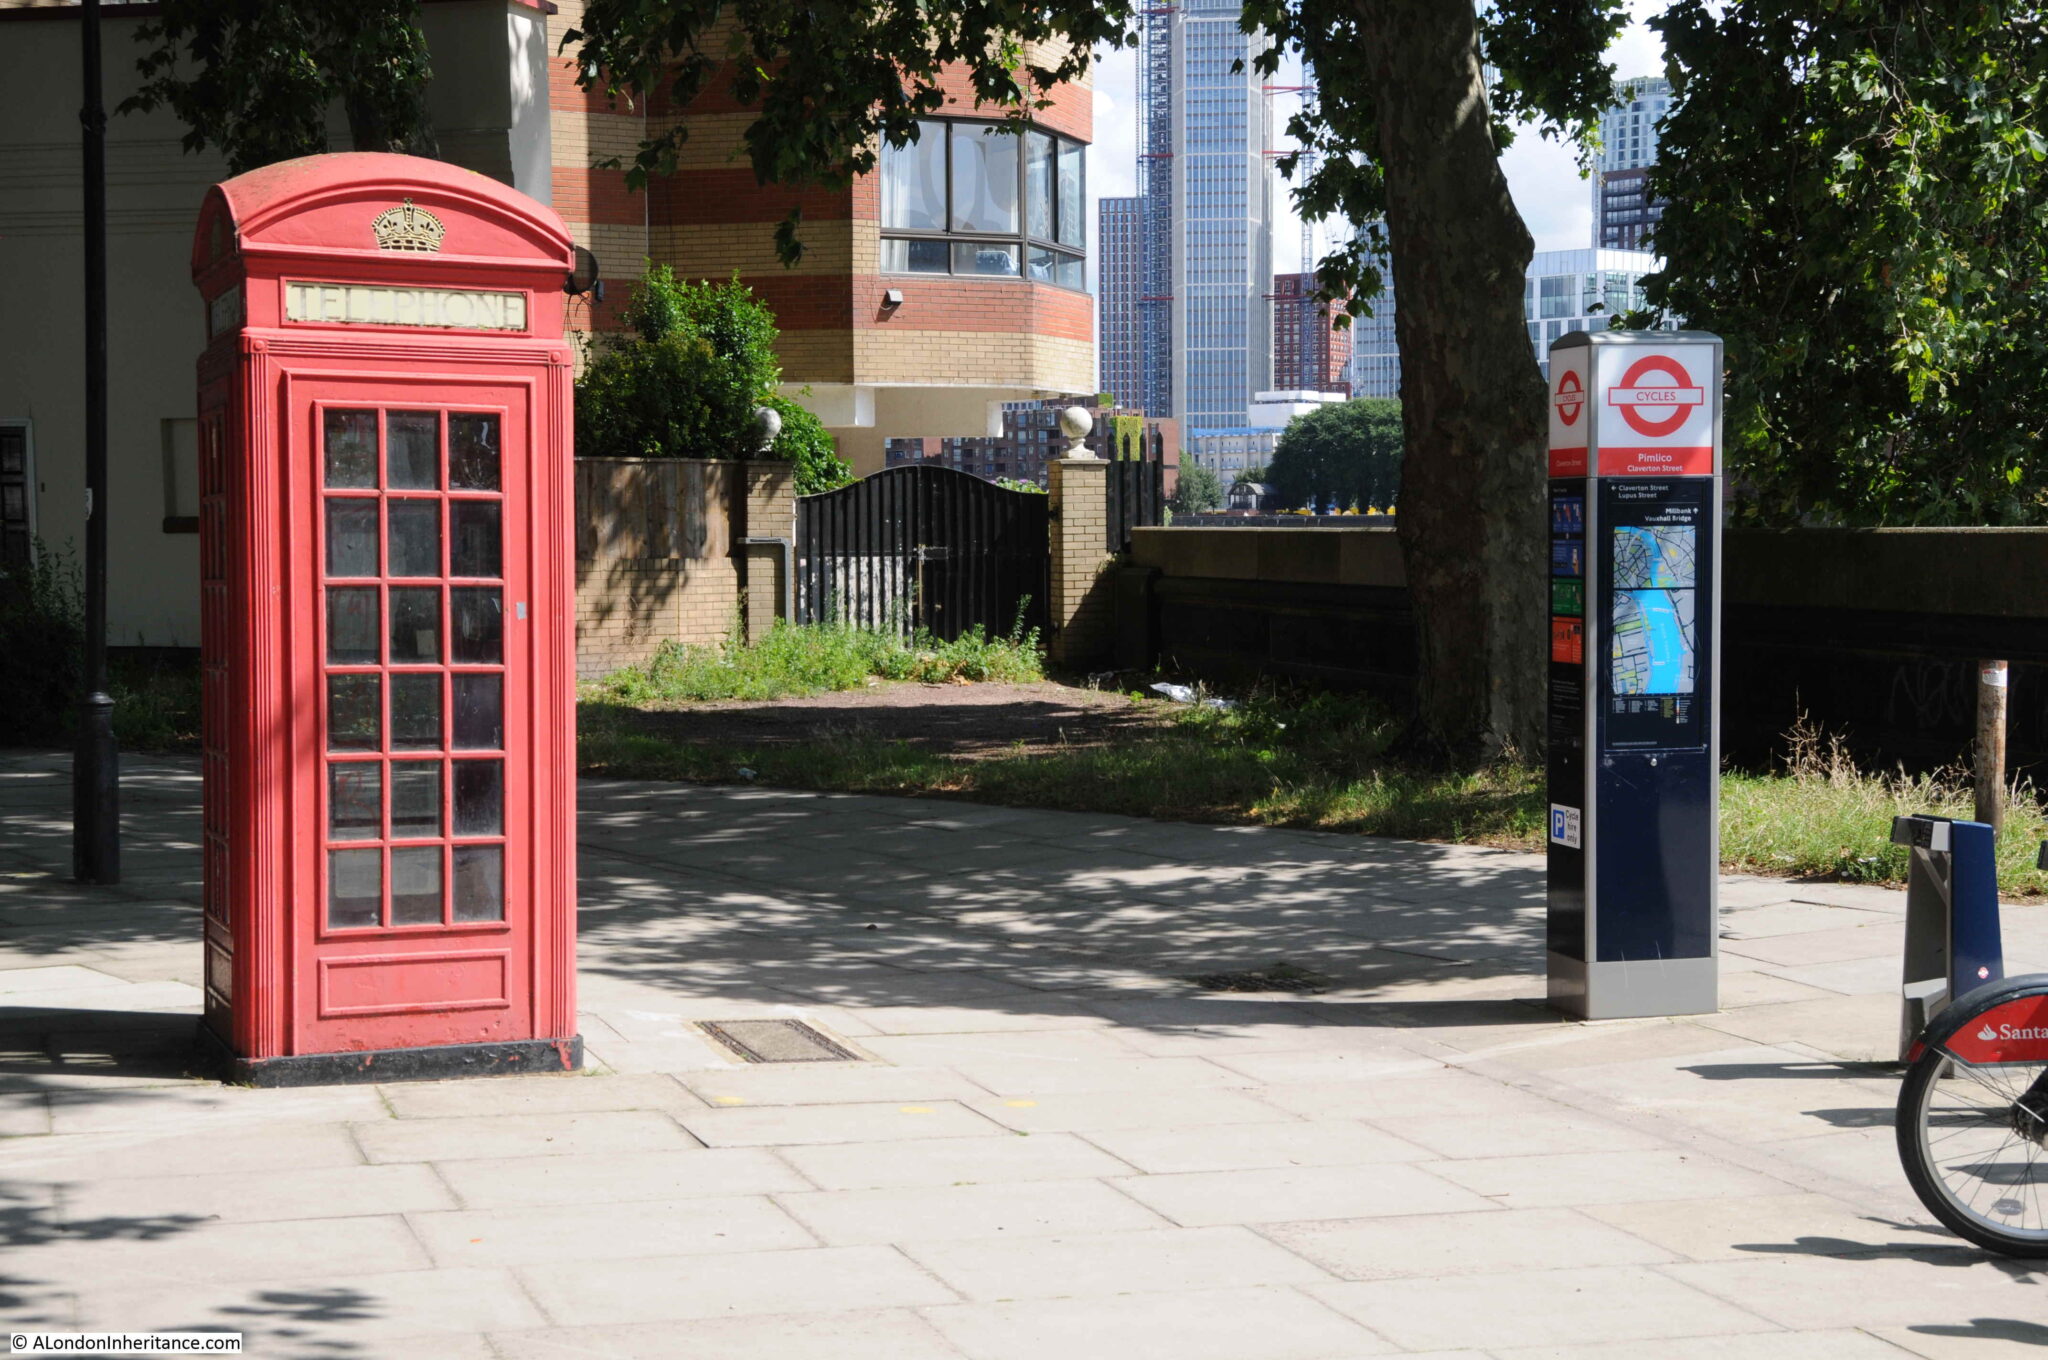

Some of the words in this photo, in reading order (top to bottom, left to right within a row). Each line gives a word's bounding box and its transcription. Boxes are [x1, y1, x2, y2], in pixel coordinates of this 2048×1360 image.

[290, 284, 524, 328] TELEPHONE
[1636, 391, 1676, 402] CYCLES
[1638, 453, 1673, 462] Pimlico
[1618, 492, 1637, 500] Lupus
[1672, 515, 1692, 523] Bridge
[1566, 809, 1579, 821] Cycle
[1555, 813, 1564, 836] P
[1567, 821, 1577, 832] hire
[1567, 833, 1578, 845] only
